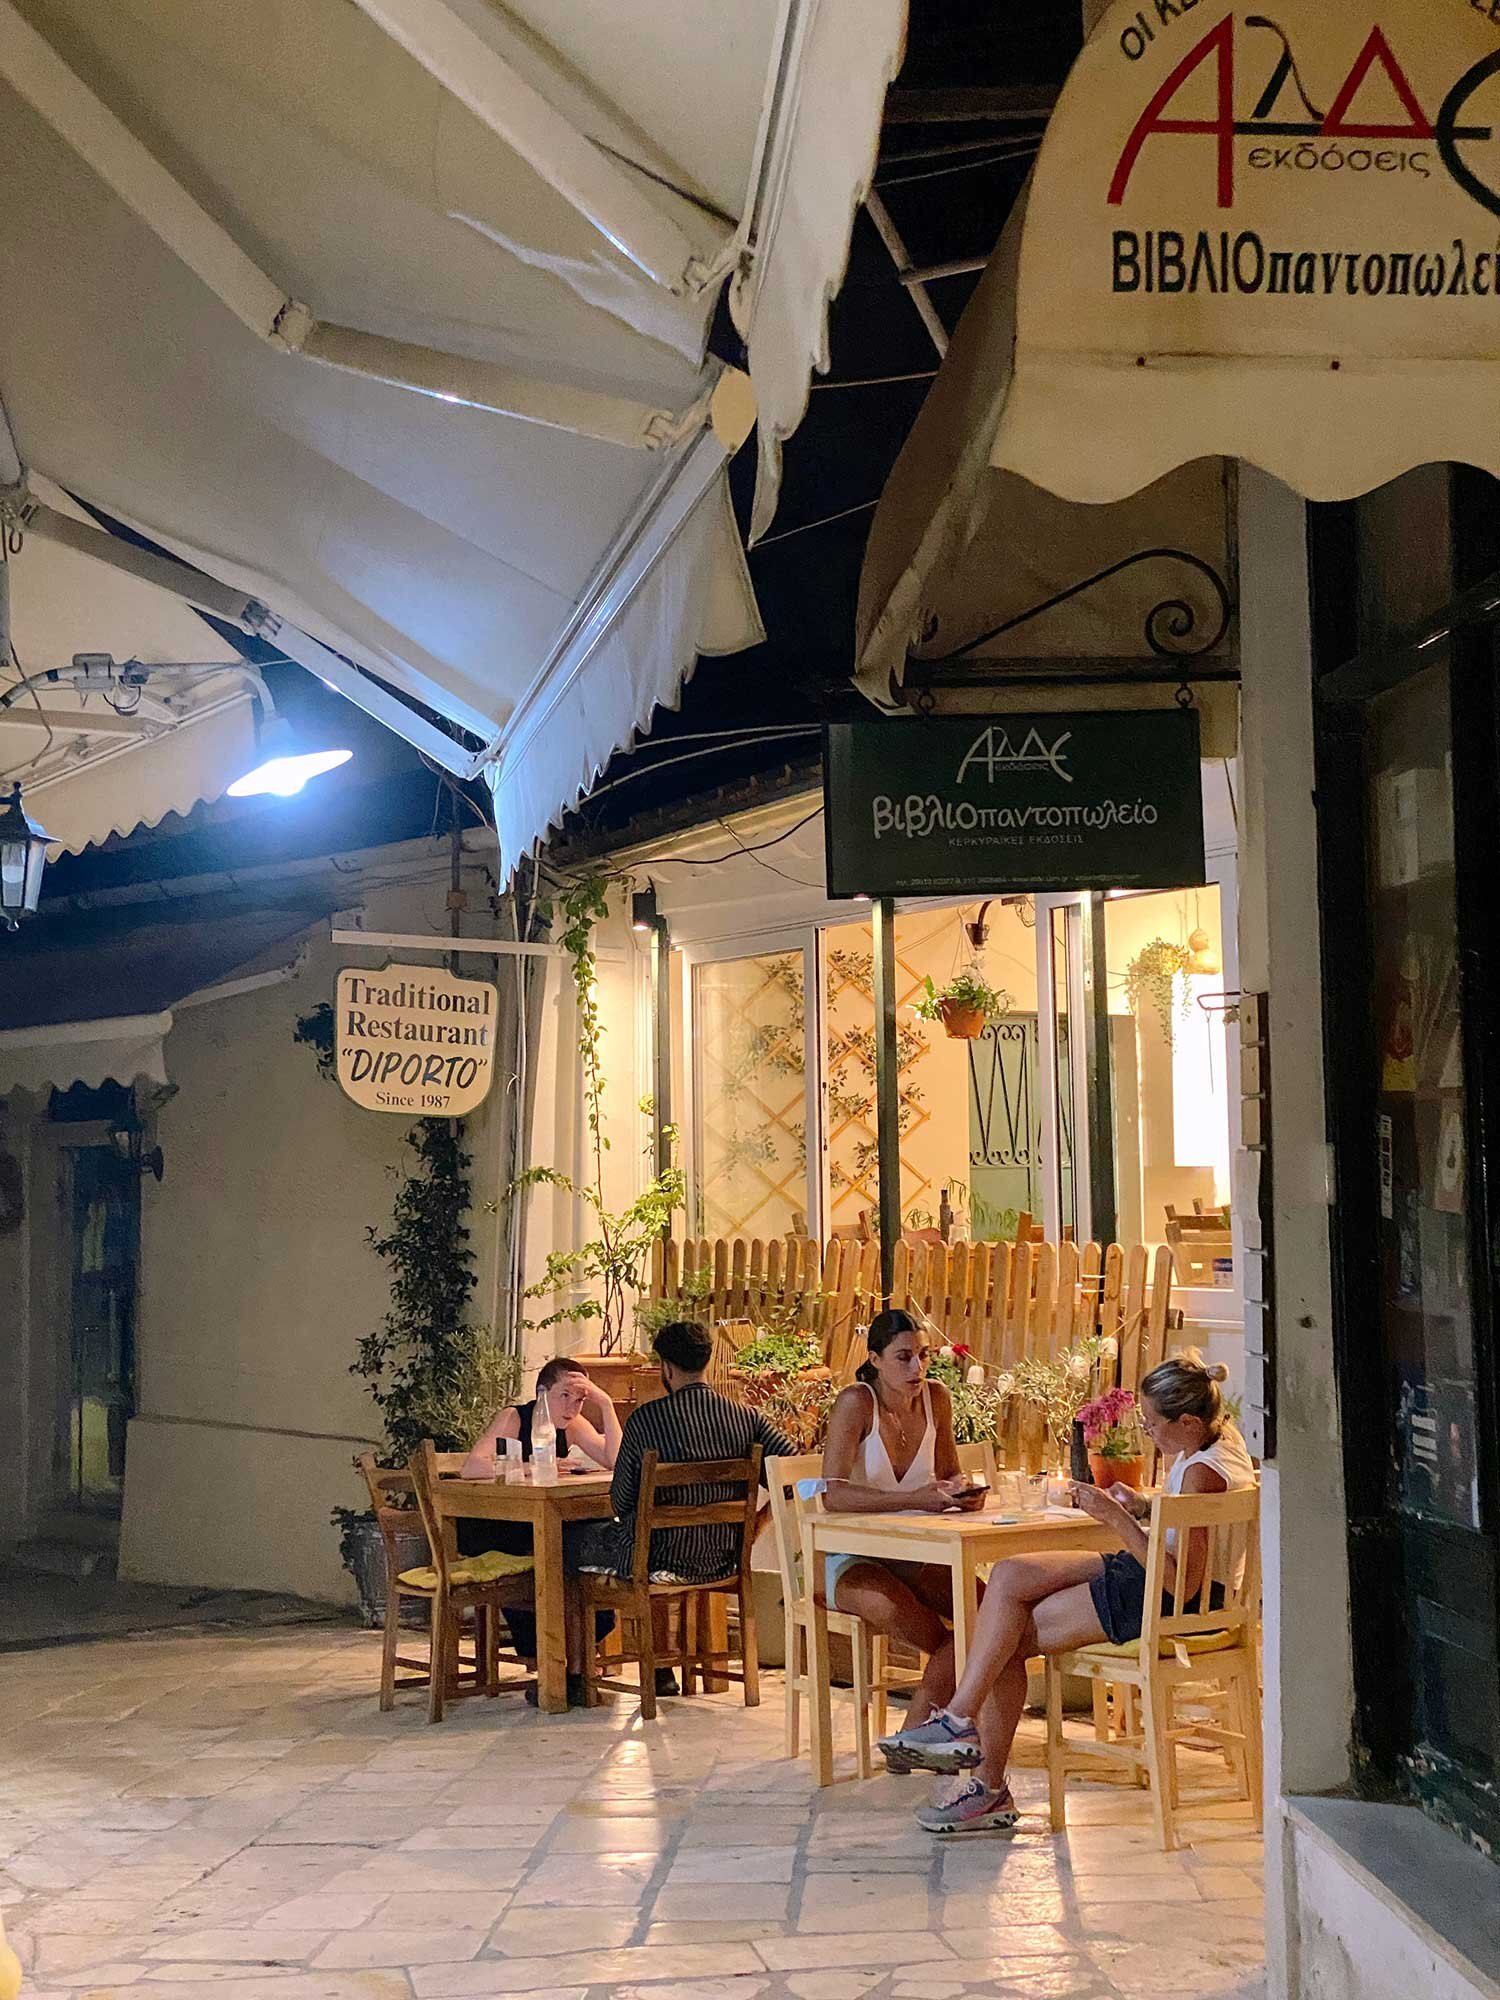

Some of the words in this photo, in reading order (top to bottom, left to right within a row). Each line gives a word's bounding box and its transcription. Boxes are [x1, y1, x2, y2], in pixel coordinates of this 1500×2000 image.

[1248, 143, 1431, 178] εκδόσεις
[1029, 833, 1085, 845] ΕΚΔΟΣΕΙΣ
[345, 977, 490, 1015] Traditional
[346, 1009, 488, 1046] Restaurant
[375, 1092, 414, 1107] Since
[420, 1094, 450, 1108] 1987
